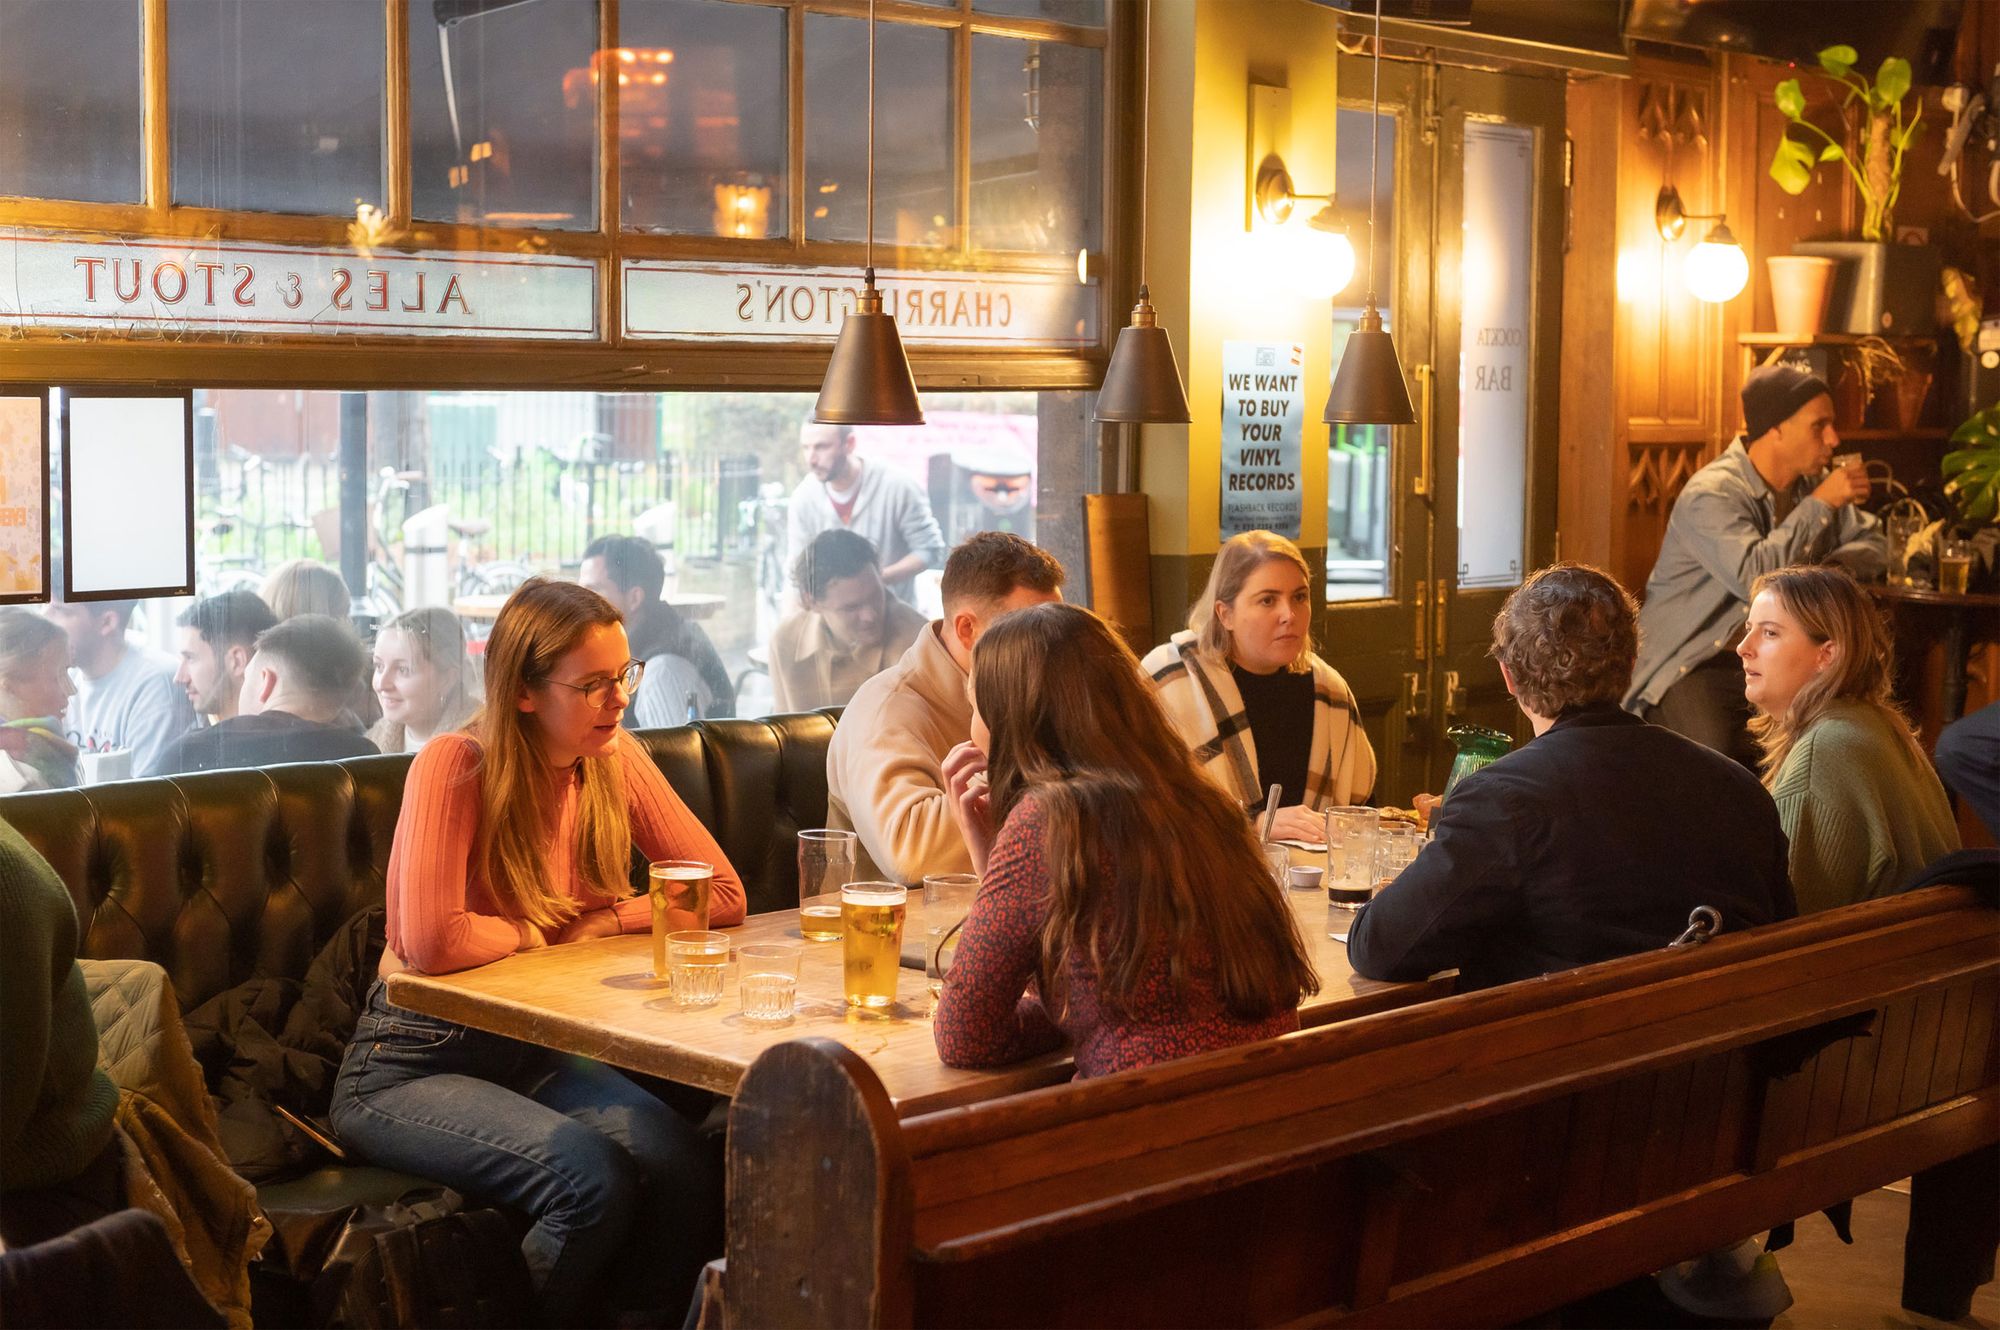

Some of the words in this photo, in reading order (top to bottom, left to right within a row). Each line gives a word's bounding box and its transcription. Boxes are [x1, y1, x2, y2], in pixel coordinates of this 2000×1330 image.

[1228, 373, 1250, 391] WE
[1255, 374, 1298, 392] WANT
[1238, 399, 1257, 417] TO
[1260, 399, 1290, 417] BUY
[1241, 423, 1282, 442] YOUR
[1240, 448, 1281, 467] VINYL
[1229, 473, 1295, 491] RECORDS
